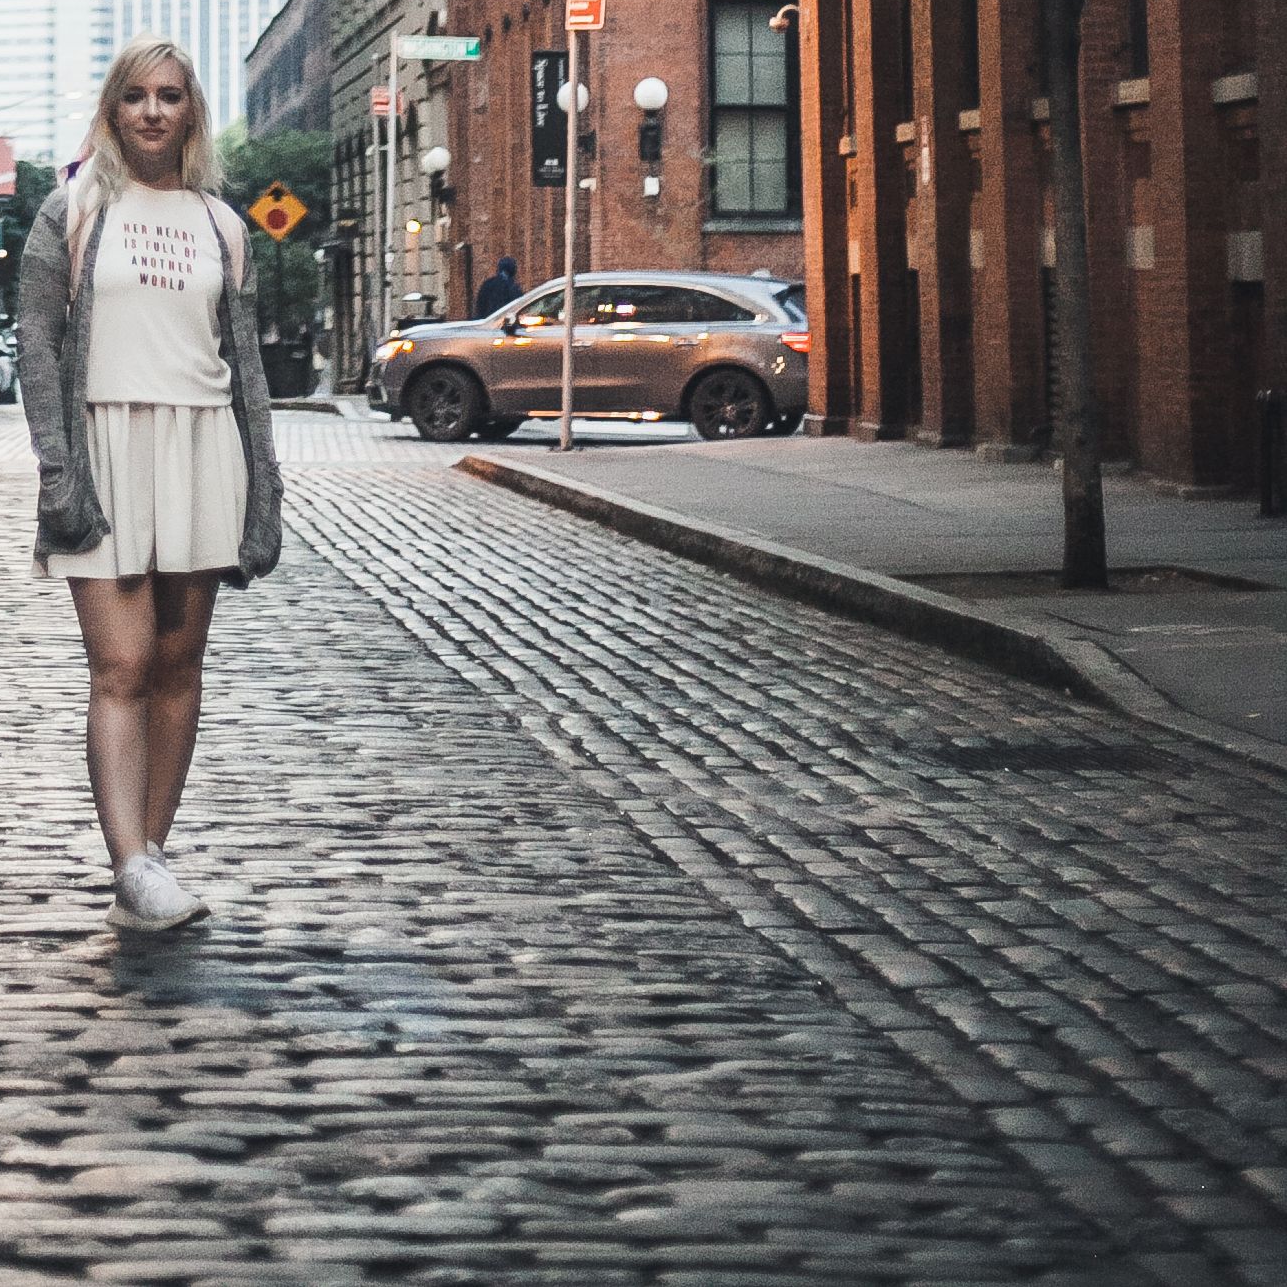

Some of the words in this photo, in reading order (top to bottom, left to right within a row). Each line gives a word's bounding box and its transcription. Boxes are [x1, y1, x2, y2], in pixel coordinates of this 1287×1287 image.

[123, 222, 148, 235] HER
[156, 226, 195, 244] HEART
[124, 237, 137, 250] IS
[146, 240, 176, 256] FULL
[184, 246, 197, 259] OF
[131, 255, 193, 275] ANOTHER
[139, 272, 185, 291] WORLD
